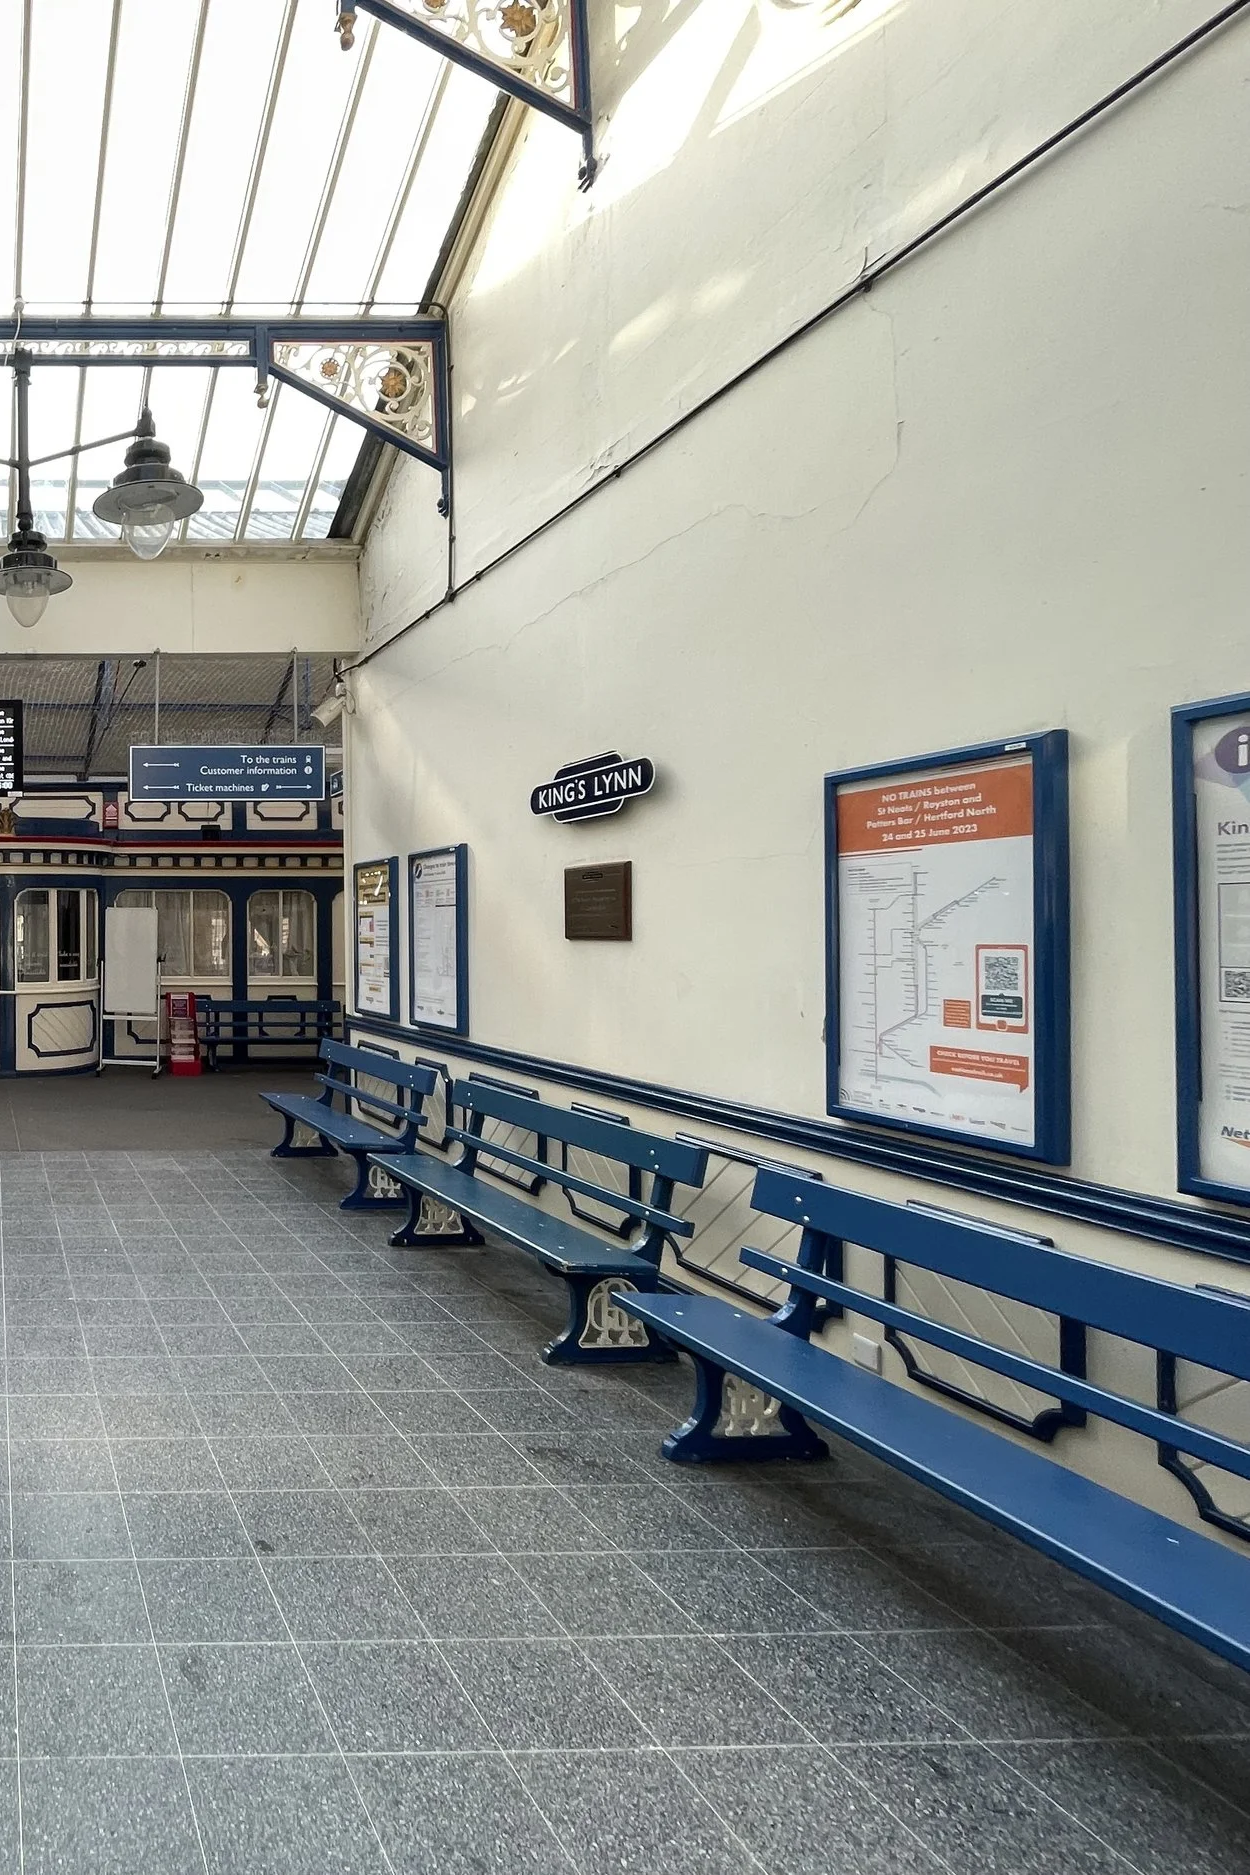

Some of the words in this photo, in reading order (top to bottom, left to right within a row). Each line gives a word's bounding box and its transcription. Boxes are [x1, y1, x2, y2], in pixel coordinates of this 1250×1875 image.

[240, 755, 254, 764] To
[256, 756, 270, 764] the
[200, 766, 244, 775] Customer
[246, 766, 297, 774] information
[186, 783, 214, 792] Ticket
[216, 784, 254, 792] machines
[538, 779, 586, 808] KING'S
[594, 766, 642, 796] LYNN
[882, 794, 896, 802] NO
[899, 788, 932, 800] TRAINS
[934, 784, 976, 796] between
[878, 807, 886, 816] St
[924, 800, 960, 810] Royston
[962, 793, 982, 804] and
[898, 816, 914, 825] Bar
[924, 808, 964, 822] Hertford
[966, 805, 996, 817] North
[882, 833, 894, 842] 24
[896, 830, 912, 840] and
[914, 829, 926, 838] 25
[929, 828, 950, 838] June
[952, 824, 978, 835] 2023
[1218, 821, 1250, 836] Kin
